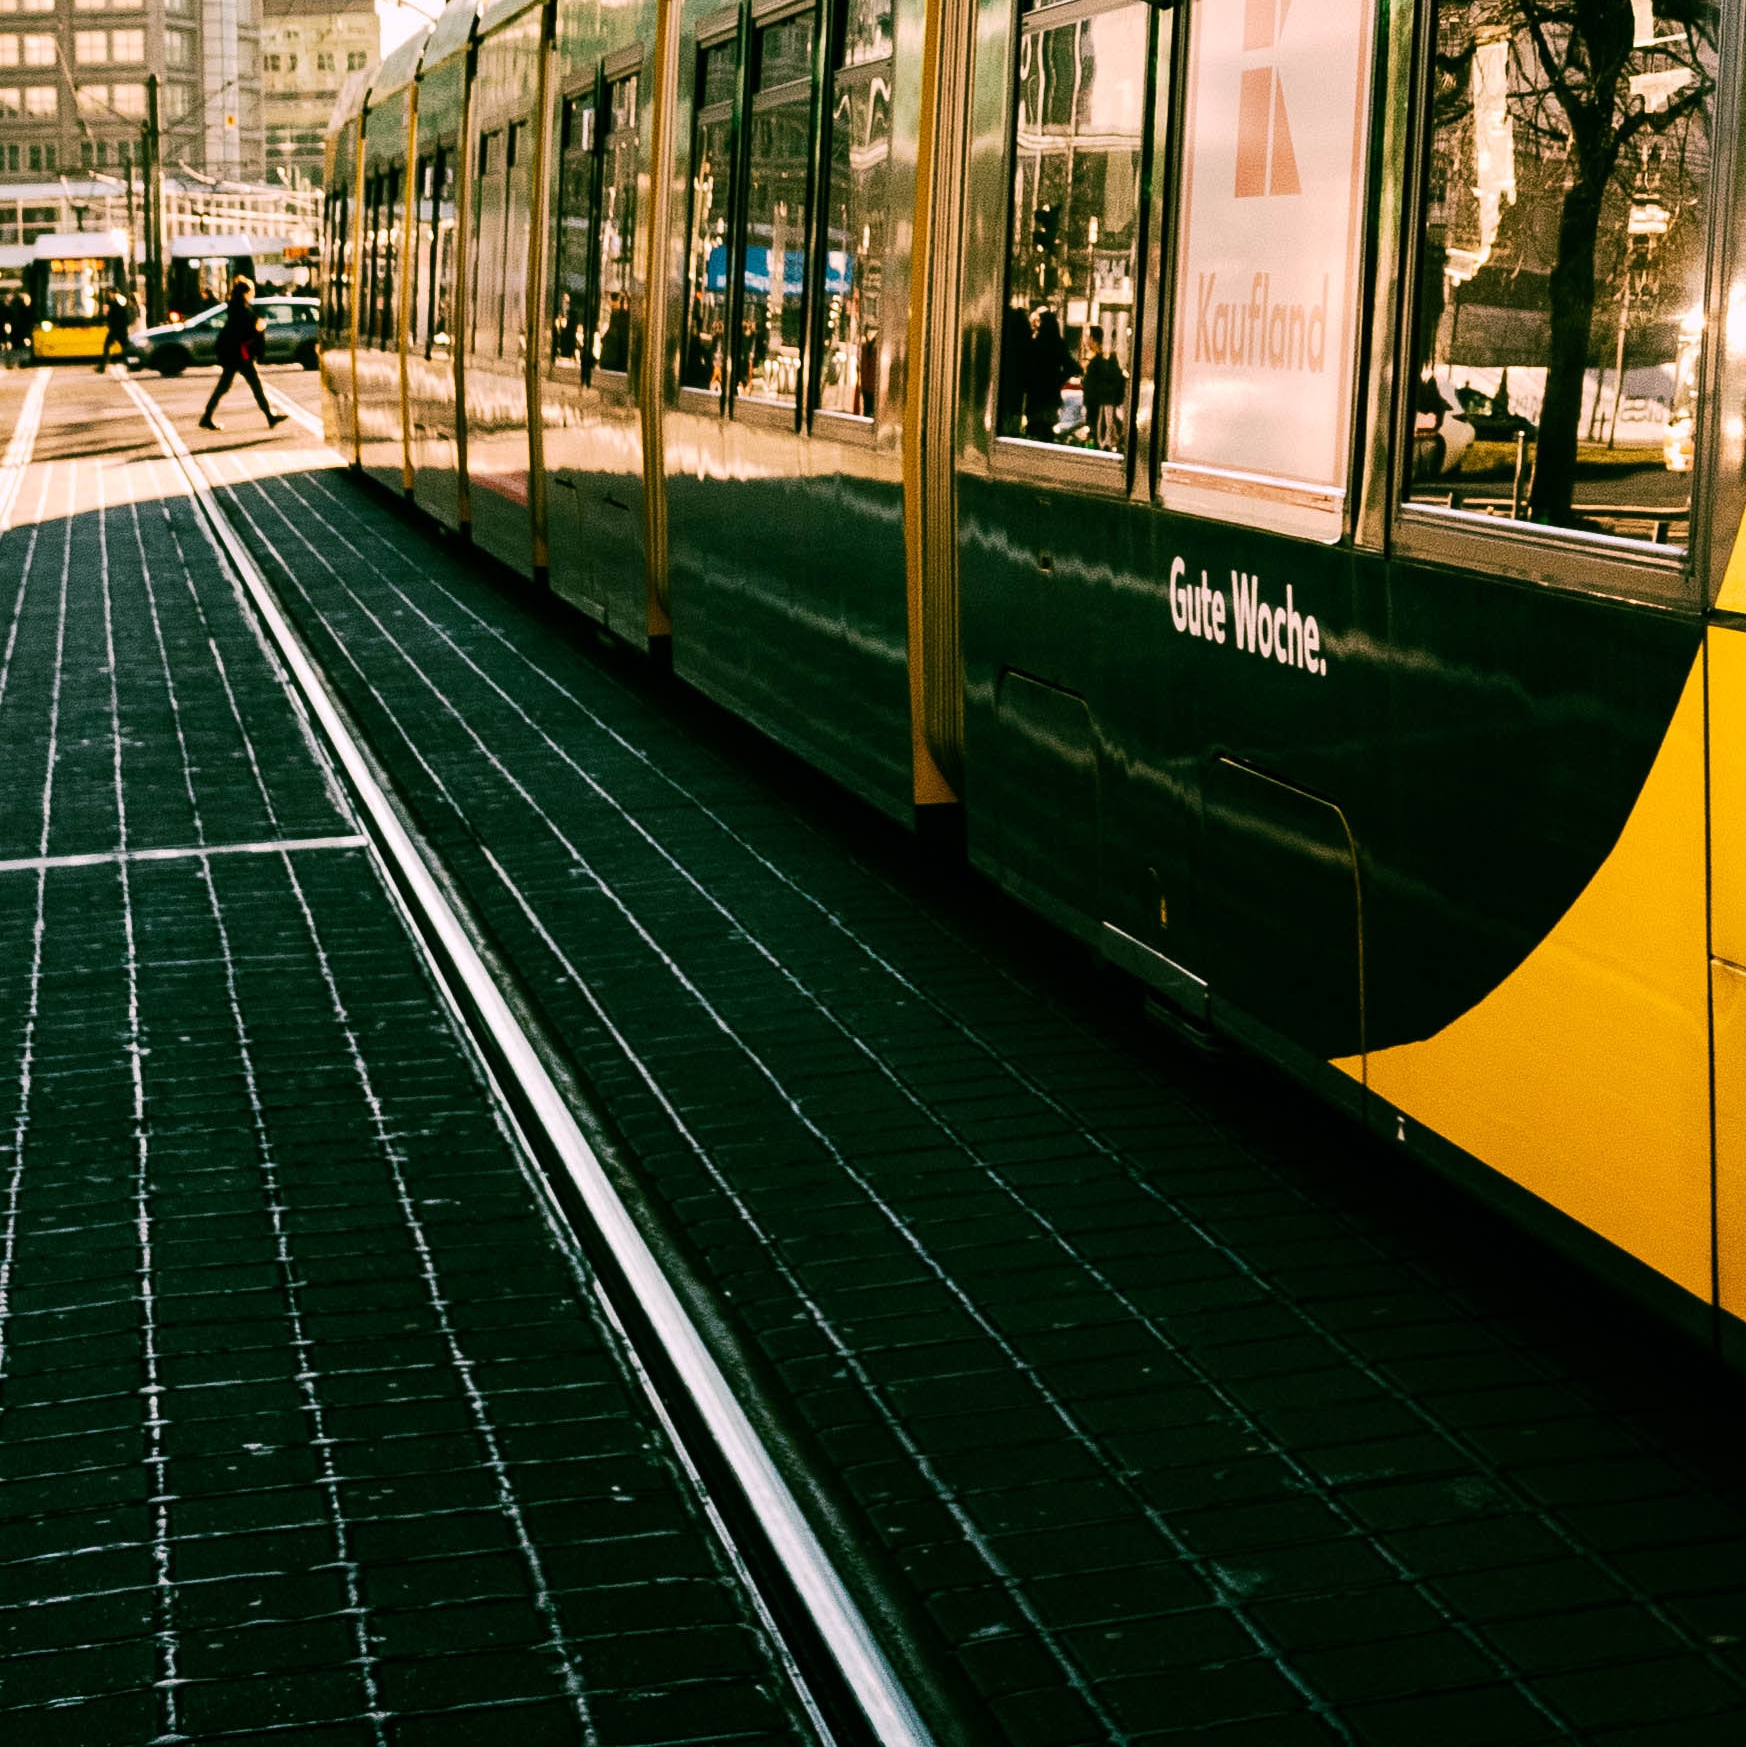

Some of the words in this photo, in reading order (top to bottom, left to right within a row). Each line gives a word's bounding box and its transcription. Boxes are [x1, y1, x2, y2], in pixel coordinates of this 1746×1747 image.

[1194, 272, 1329, 372] Kaufland
[1169, 555, 1226, 645] Gute
[1231, 570, 1327, 677] Woche.
